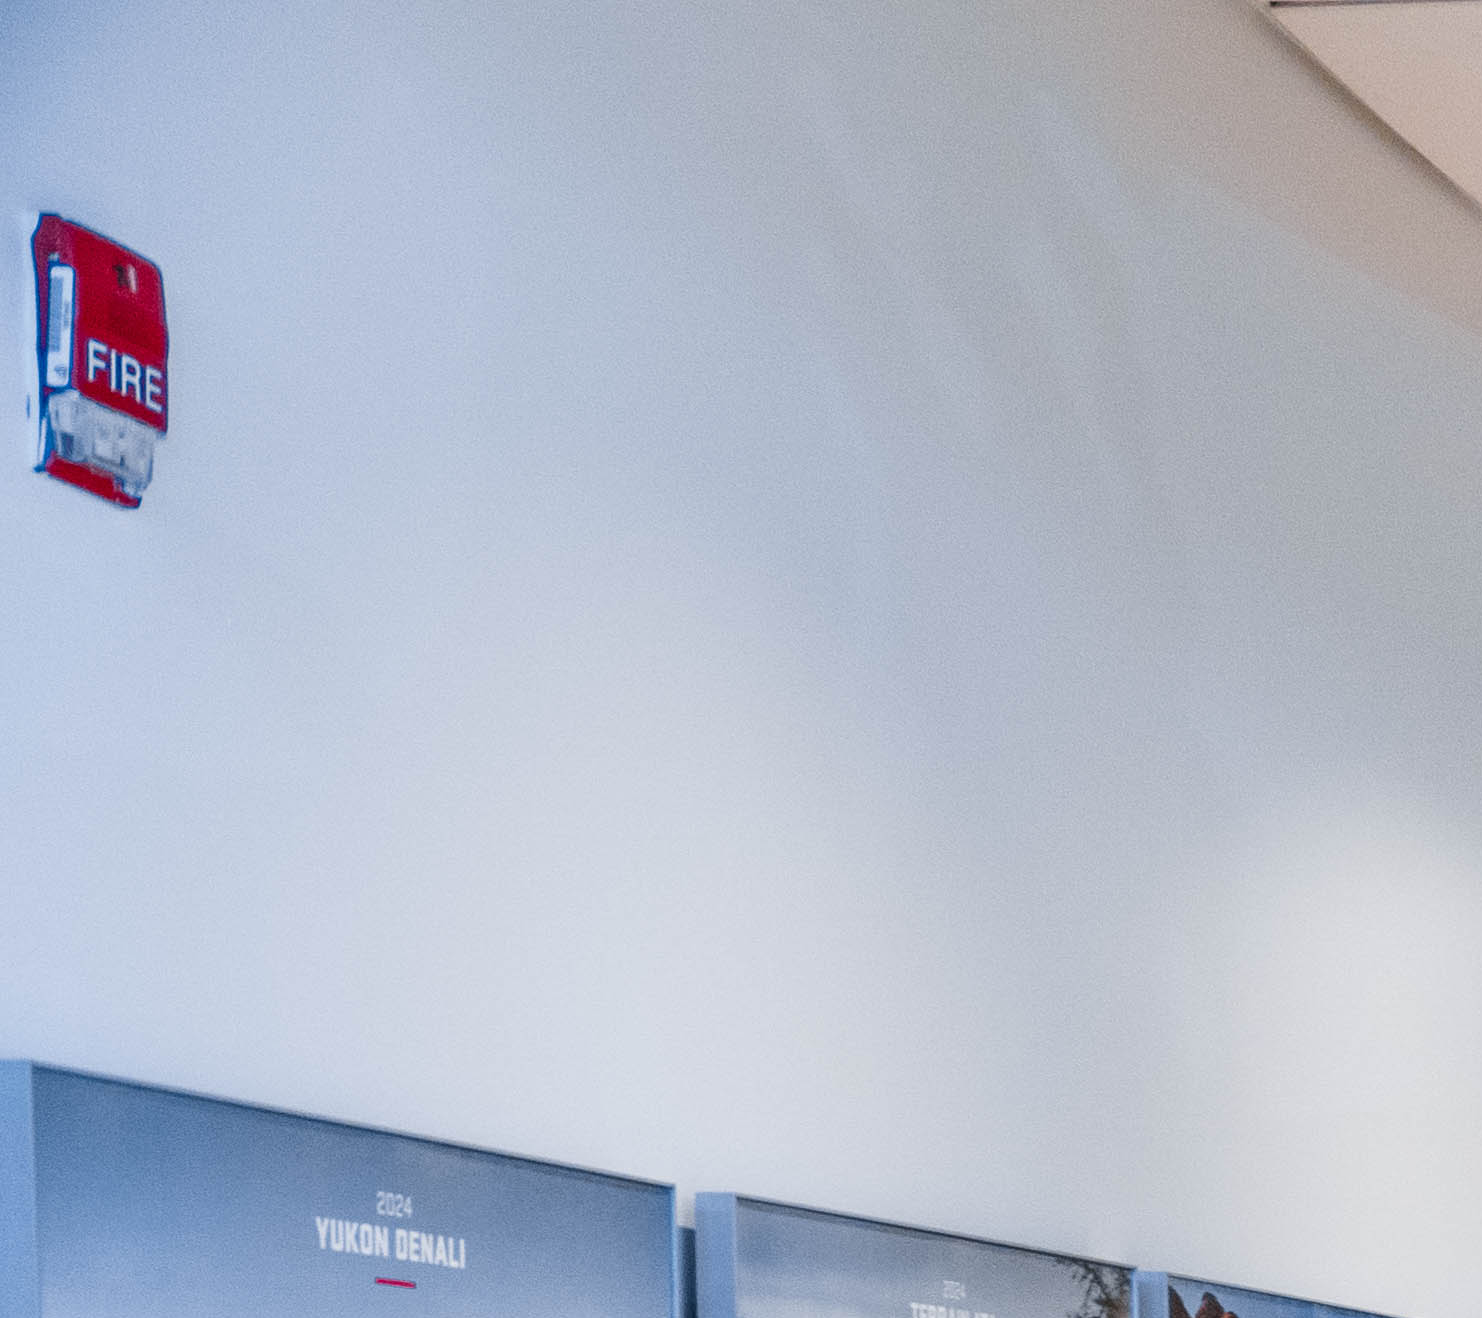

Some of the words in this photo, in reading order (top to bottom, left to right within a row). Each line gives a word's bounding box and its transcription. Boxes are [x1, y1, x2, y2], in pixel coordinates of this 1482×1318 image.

[87, 338, 163, 413] FIRE
[375, 1190, 414, 1218] 2024
[314, 1215, 390, 1258] YUKON
[394, 1227, 467, 1270] DENALI
